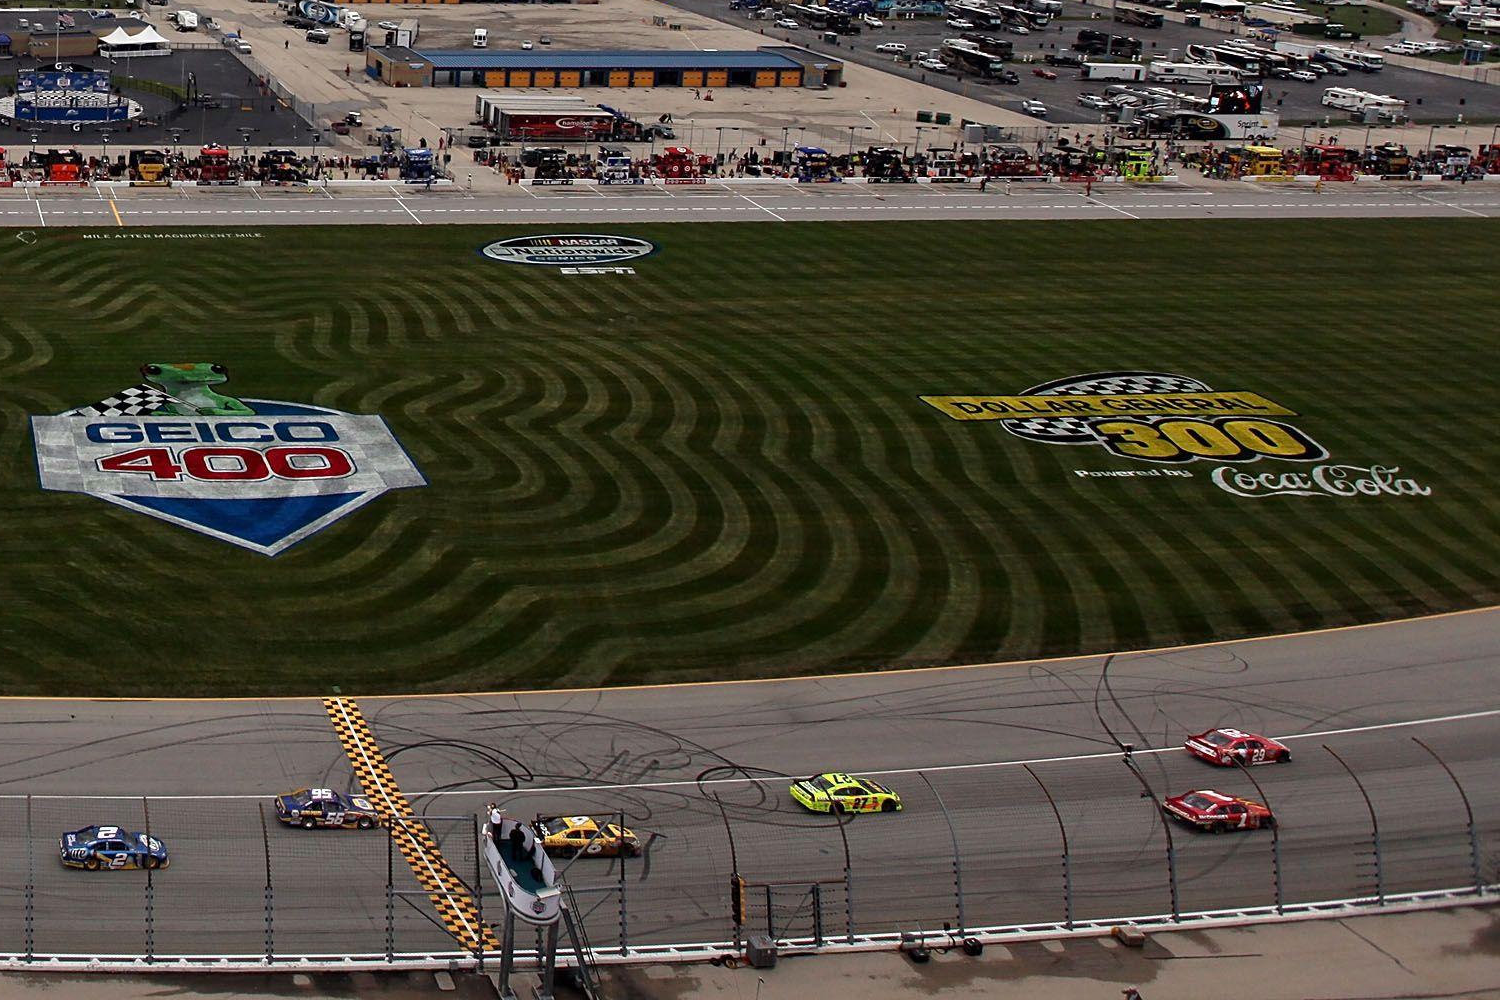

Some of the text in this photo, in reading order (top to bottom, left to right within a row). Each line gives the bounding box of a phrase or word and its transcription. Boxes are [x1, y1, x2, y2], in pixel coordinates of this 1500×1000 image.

[55, 62, 62, 70] G
[73, 123, 80, 131] G
[1237, 120, 1259, 128] Sprint
[515, 246, 642, 255] Nationwide
[559, 267, 636, 275] ESPN
[950, 396, 1269, 415] DOLLAR GENERAL
[85, 421, 341, 444] GEICO
[1096, 420, 1307, 459] 300
[96, 446, 357, 483] 400
[1074, 468, 1194, 479] Powered by
[1252, 748, 1266, 761] 29
[852, 797, 869, 810] 27
[325, 812, 345, 825] 56
[1237, 812, 1247, 828] 1
[97, 826, 119, 839] 2
[111, 853, 129, 867] 2
